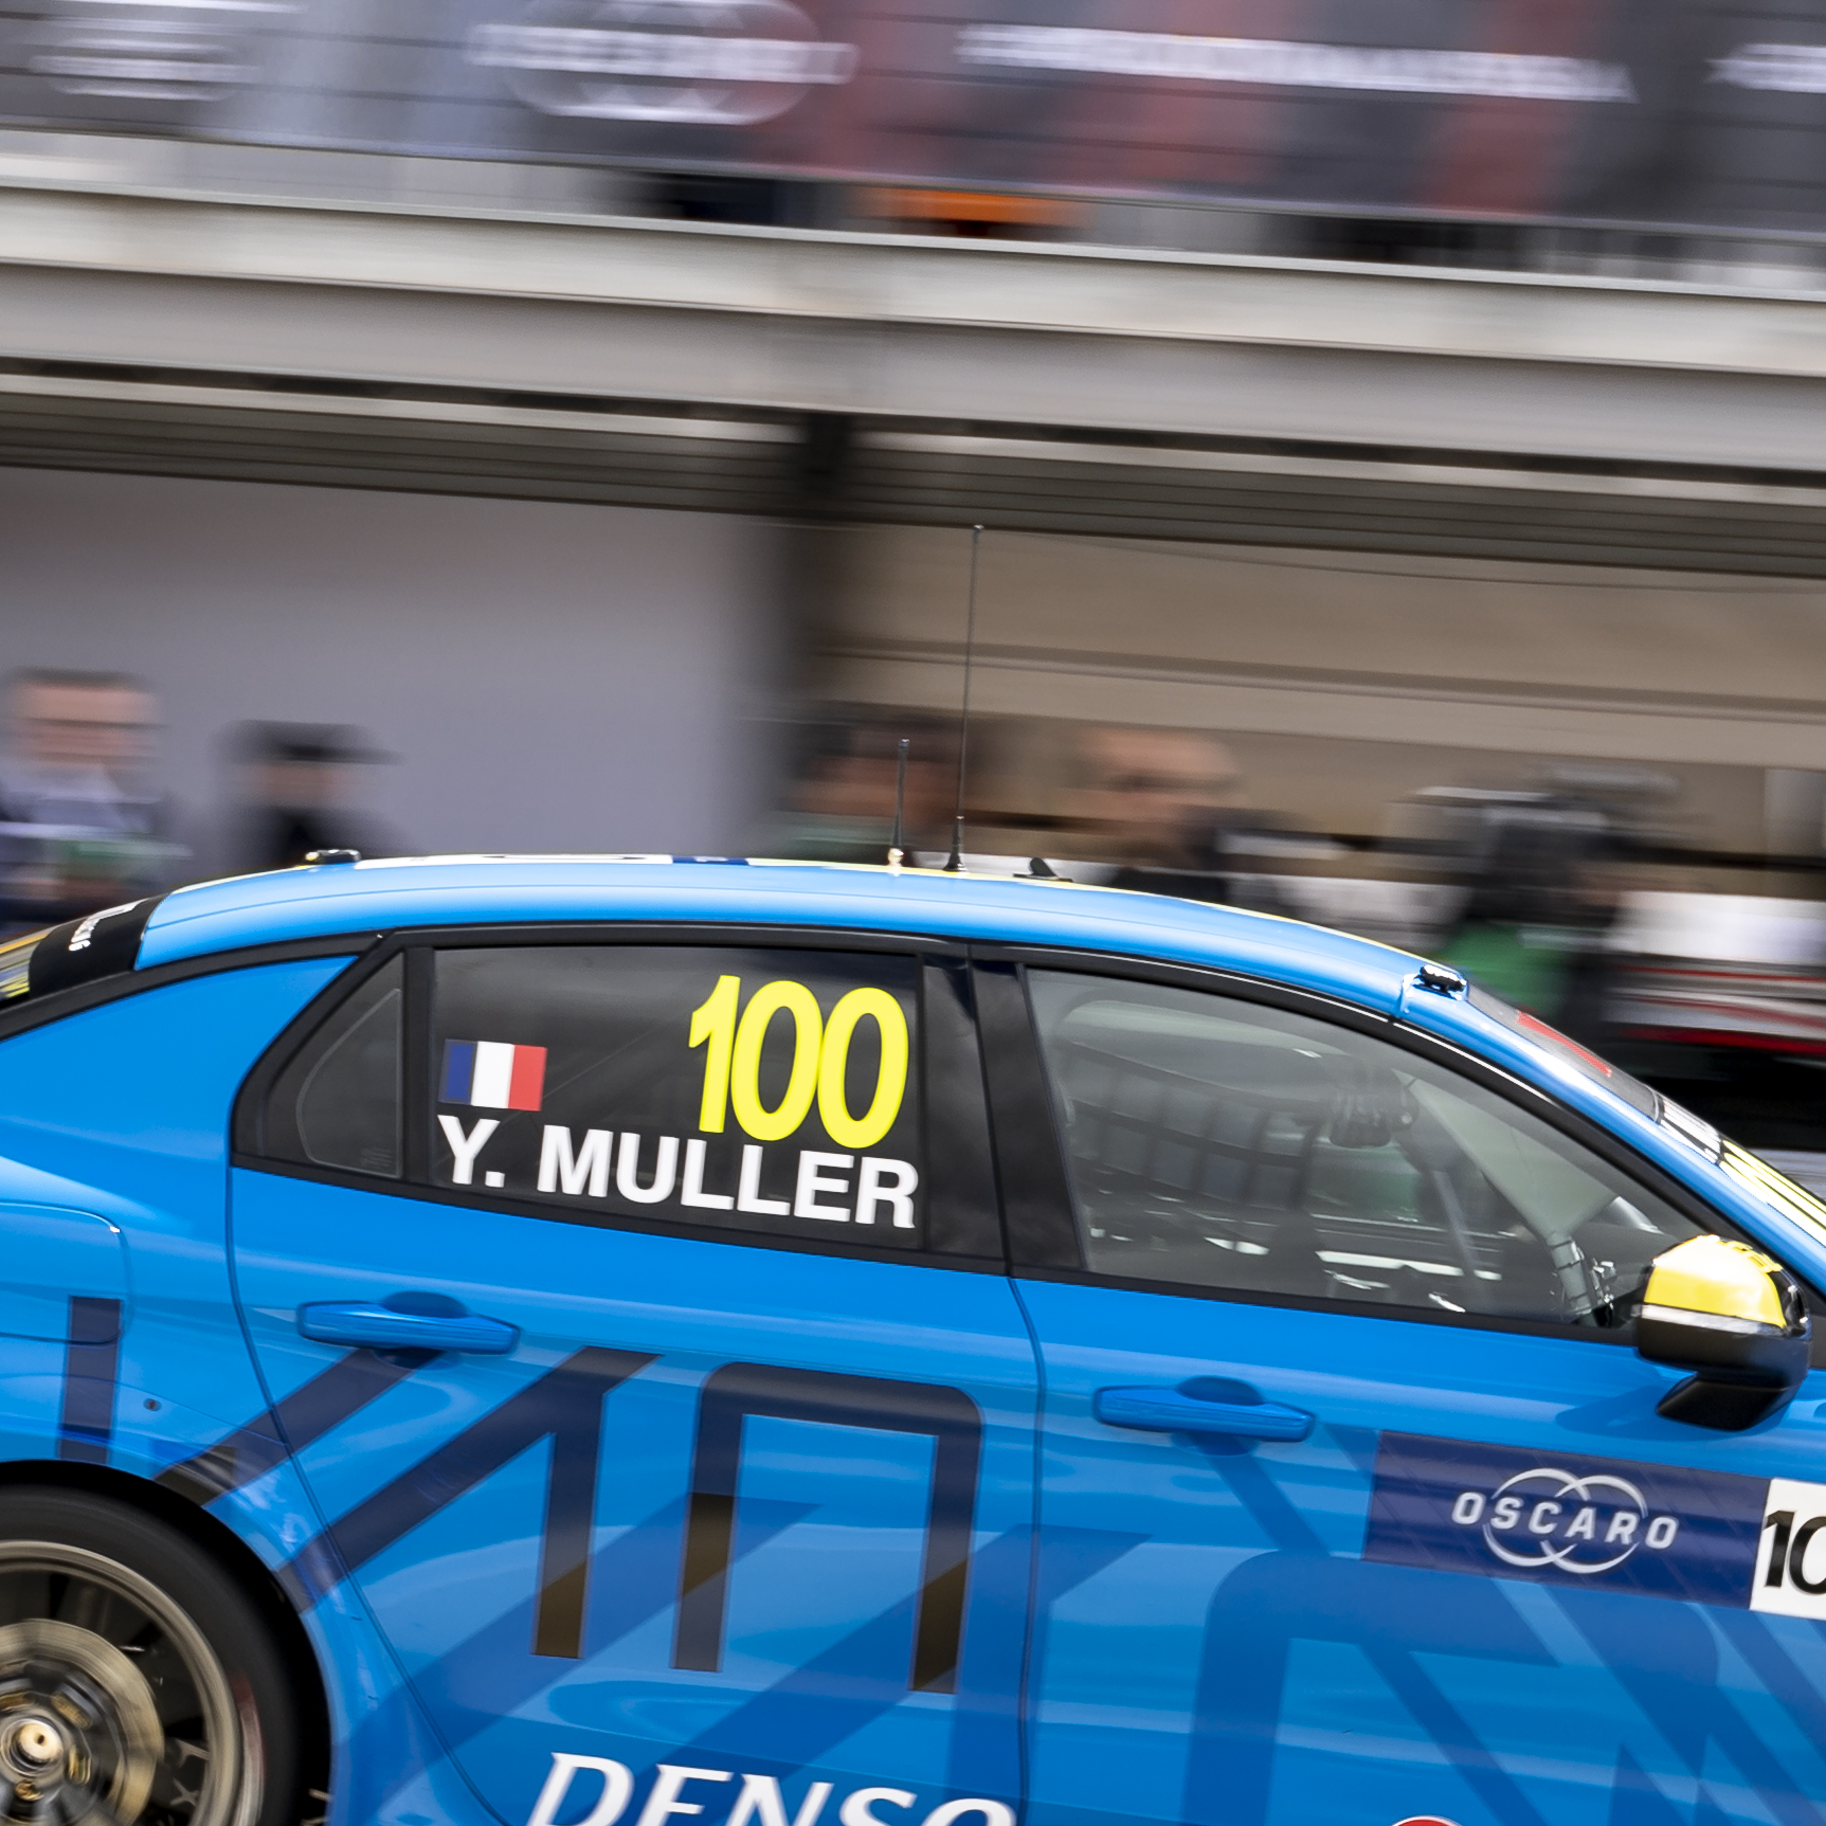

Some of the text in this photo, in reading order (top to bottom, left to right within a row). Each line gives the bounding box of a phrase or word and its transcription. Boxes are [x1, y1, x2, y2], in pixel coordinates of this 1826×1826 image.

[688, 975, 909, 1148] 100
[437, 1114, 919, 1229] Y. MULLER
[1451, 1491, 1679, 1551] OSCARO
